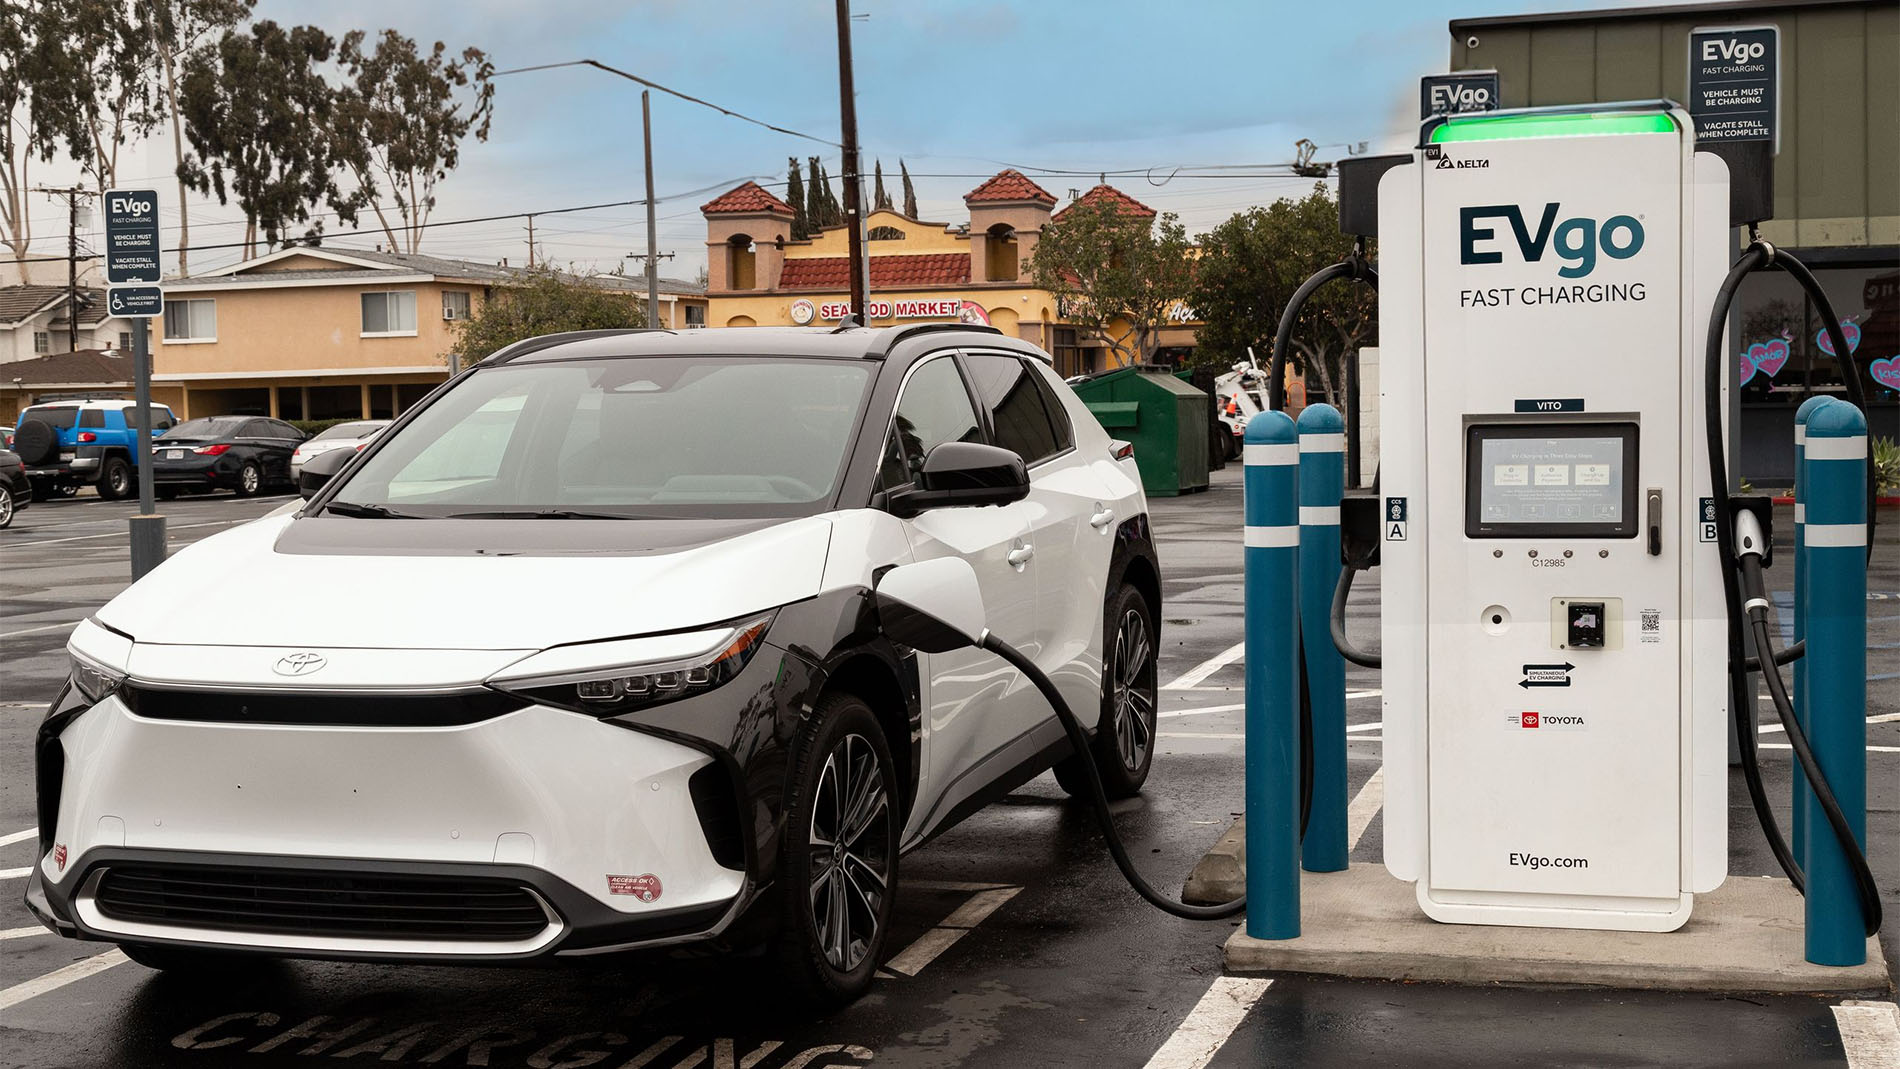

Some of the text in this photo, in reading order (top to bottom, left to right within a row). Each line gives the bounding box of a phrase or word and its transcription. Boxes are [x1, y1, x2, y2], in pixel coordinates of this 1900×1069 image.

[1703, 39, 1764, 64] EVgo
[1722, 64, 1764, 73] CHARGING
[1431, 84, 1489, 105] EVgo
[1703, 88, 1764, 98] VEHICLE MUST
[1717, 97, 1762, 106] CHARGING
[1704, 120, 1763, 130] VACATE STALL
[1698, 128, 1769, 138] WHEN COMPLETE
[1457, 160, 1489, 168] DELTA
[112, 198, 151, 217] EVgo
[1460, 203, 1644, 278] EVgo
[1461, 283, 1645, 307] FAST CHARGING
[822, 302, 957, 318] SEAOD MARKET
[1755, 350, 1784, 363] AMOR
[1537, 402, 1562, 410] VITO
[1390, 524, 1403, 537] A
[1705, 525, 1716, 539] B
[1532, 559, 1565, 567] C12985
[1542, 716, 1584, 725] TOYOTA
[1510, 853, 1588, 870] EVgo.com
